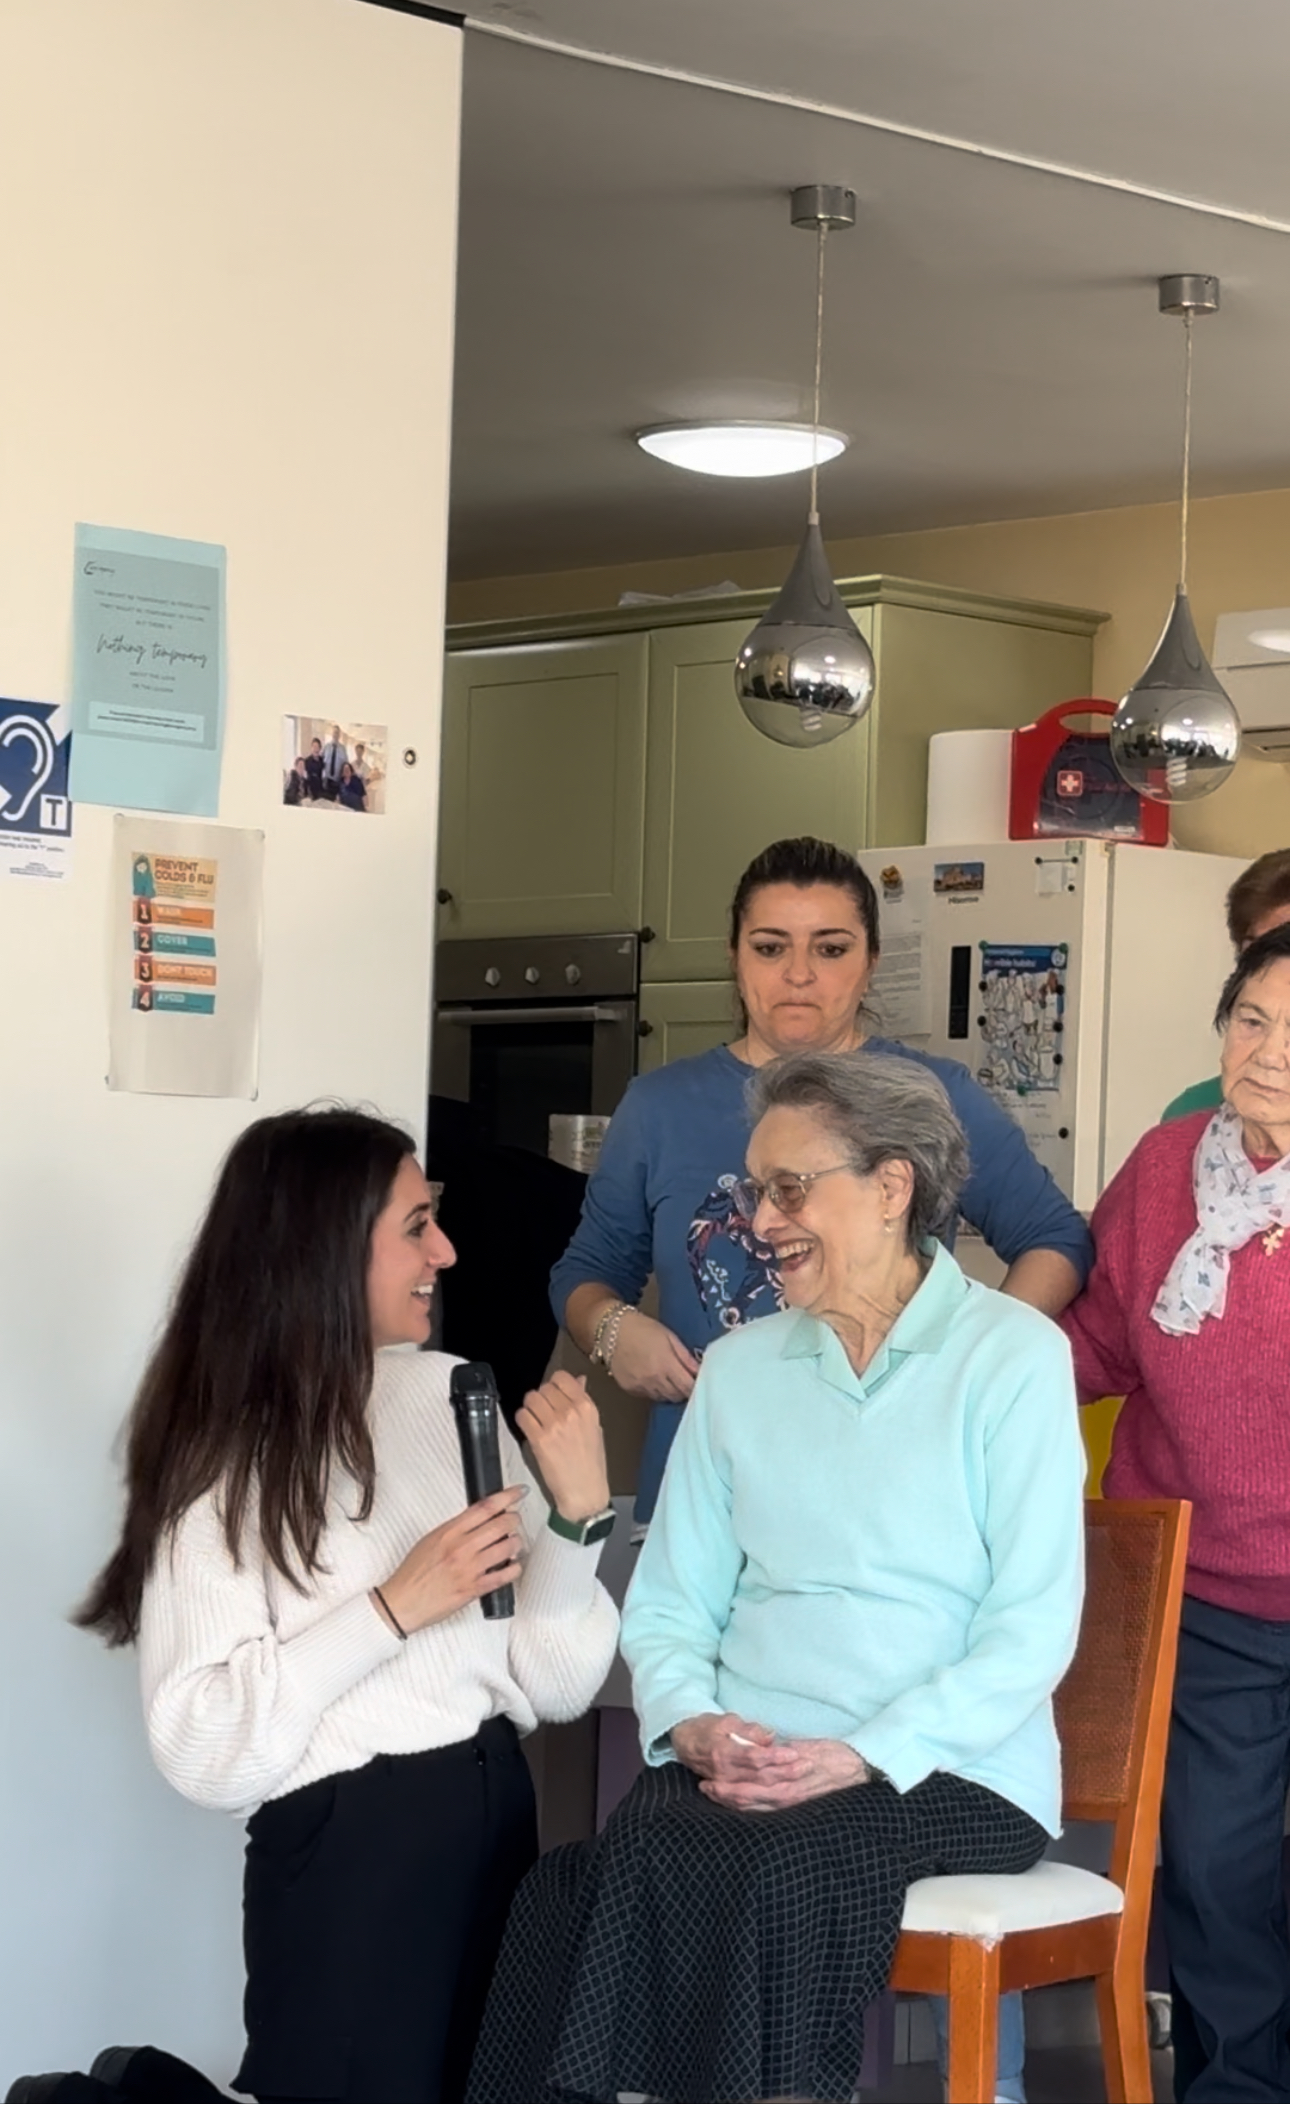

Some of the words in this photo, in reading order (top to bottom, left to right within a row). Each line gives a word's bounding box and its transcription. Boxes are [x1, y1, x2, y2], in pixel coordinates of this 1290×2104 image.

[45, 798, 63, 826] T
[155, 858, 198, 872] PREVENT
[154, 870, 186, 883] COLDS
[197, 873, 214, 884] FLU
[140, 903, 149, 920] 1
[140, 932, 150, 948] 2
[141, 961, 150, 978] 3
[139, 991, 150, 1008] 4
